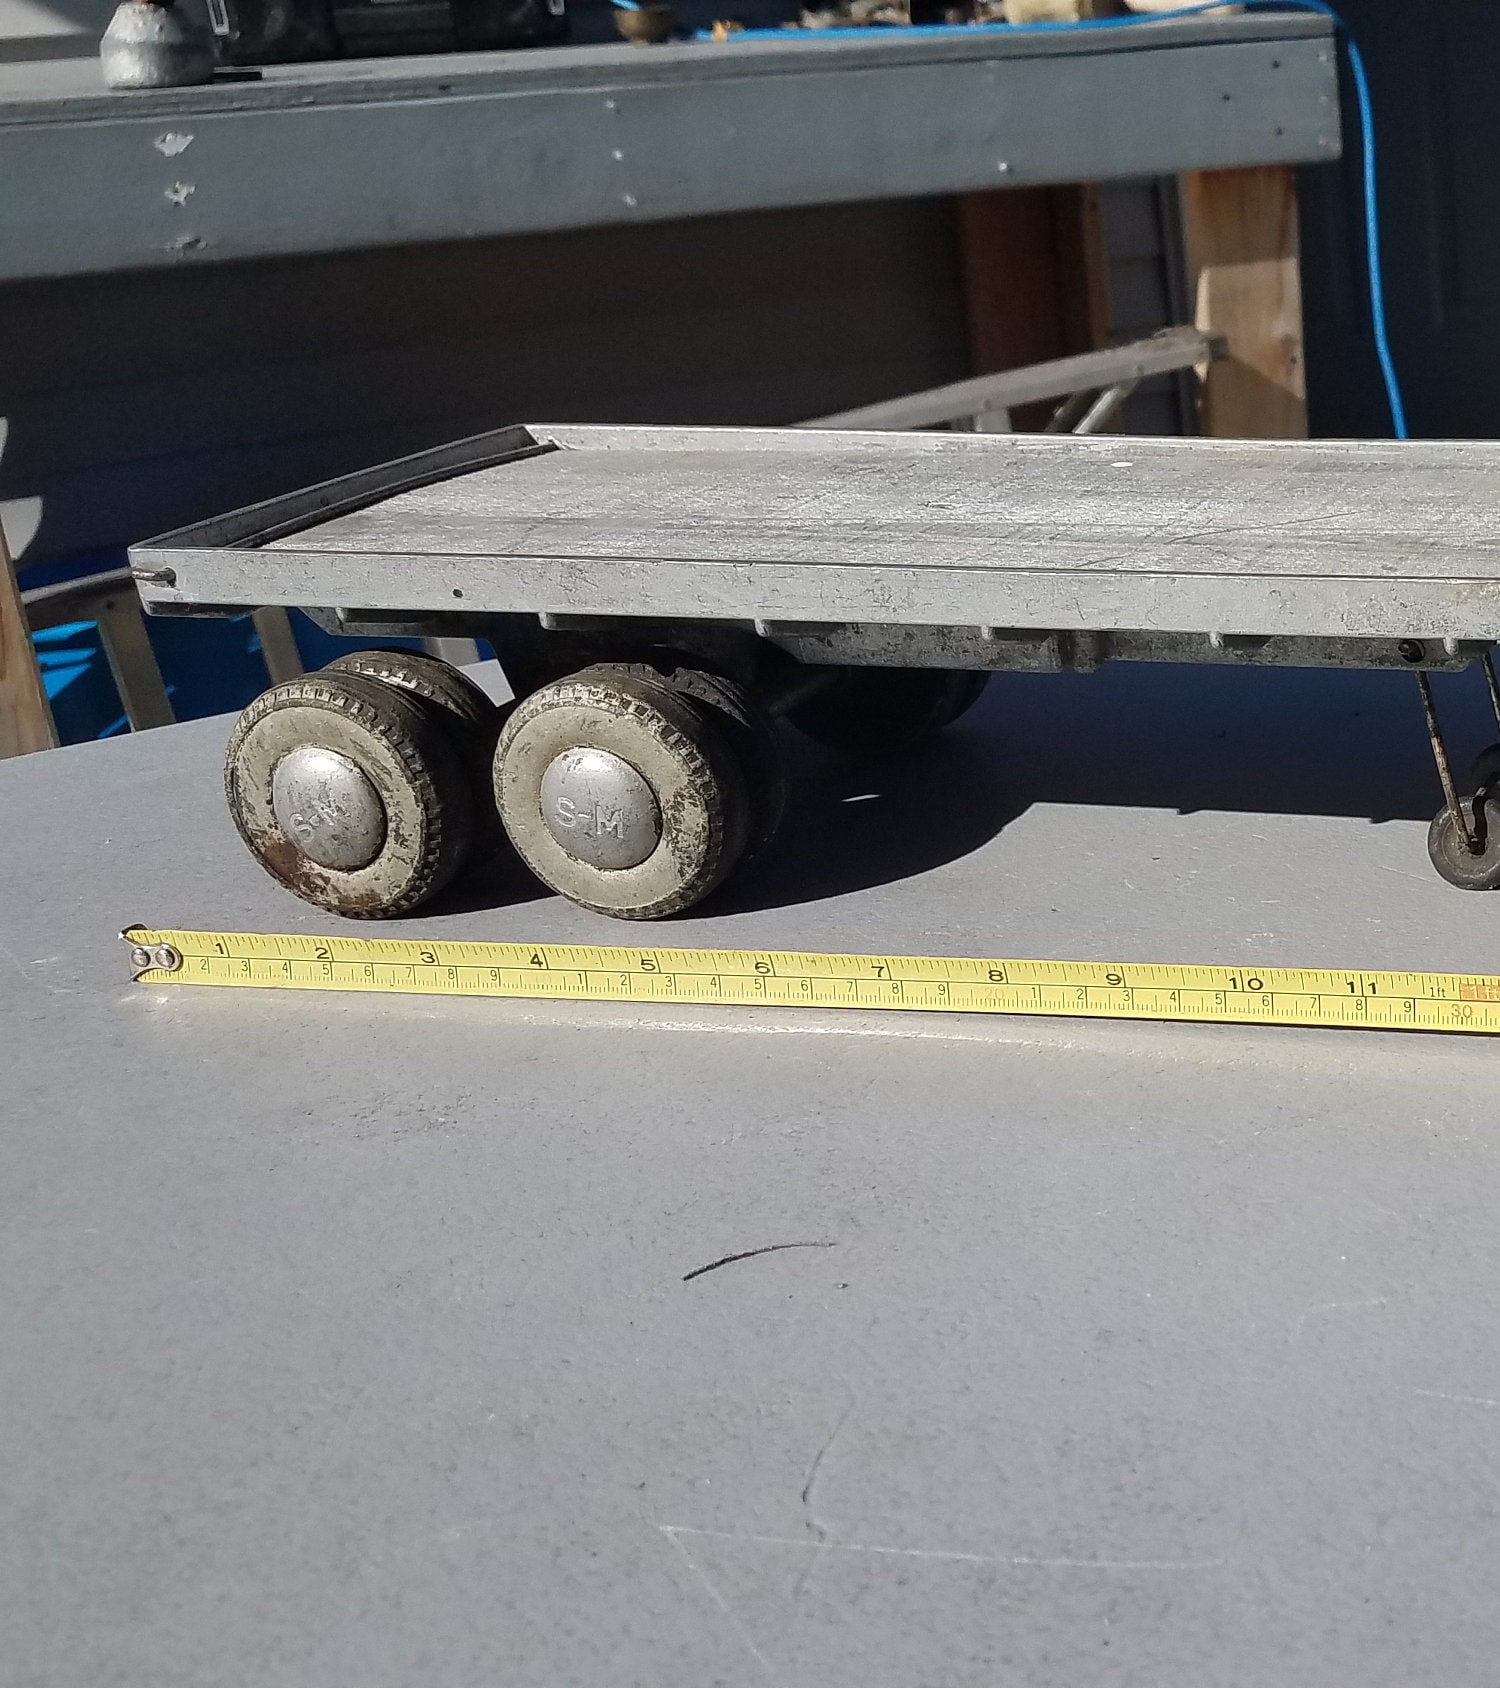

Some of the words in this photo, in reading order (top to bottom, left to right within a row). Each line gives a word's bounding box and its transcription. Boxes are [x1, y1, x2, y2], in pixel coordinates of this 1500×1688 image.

[555, 796, 624, 838] S-M
[215, 943, 224, 954] 1
[315, 947, 330, 959] 2
[421, 951, 435, 964] 3
[529, 953, 544, 967] 4
[641, 959, 656, 971] 5
[755, 961, 770, 974] 6
[871, 966, 885, 978] 7
[988, 970, 1004, 982] 8
[1106, 974, 1121, 985] 9
[201, 960, 208, 971] 2
[241, 961, 248, 972] 3
[282, 962, 289, 974] 4
[322, 964, 330, 975] 5
[364, 965, 371, 977] 6
[405, 967, 412, 978] 7
[448, 968, 455, 980] 8
[490, 970, 497, 981] 9
[578, 973, 583, 984] 1
[620, 975, 627, 986] 2
[665, 976, 673, 987] 3
[710, 978, 717, 989] 4
[754, 978, 761, 989] 5
[801, 980, 808, 991] 6
[846, 982, 854, 993] 7
[892, 983, 899, 994] 8
[938, 985, 946, 996] 9
[1032, 987, 1037, 998] 1
[1077, 989, 1084, 1000] 2
[1123, 990, 1130, 1002] 3
[1169, 991, 1176, 1002] 4
[1215, 993, 1222, 1004] 5
[1262, 995, 1269, 1007] 6
[1310, 997, 1317, 1008] 7
[1355, 999, 1363, 1011] 8
[1403, 1001, 1411, 1012] 9
[1451, 1004, 1473, 1019] 30
